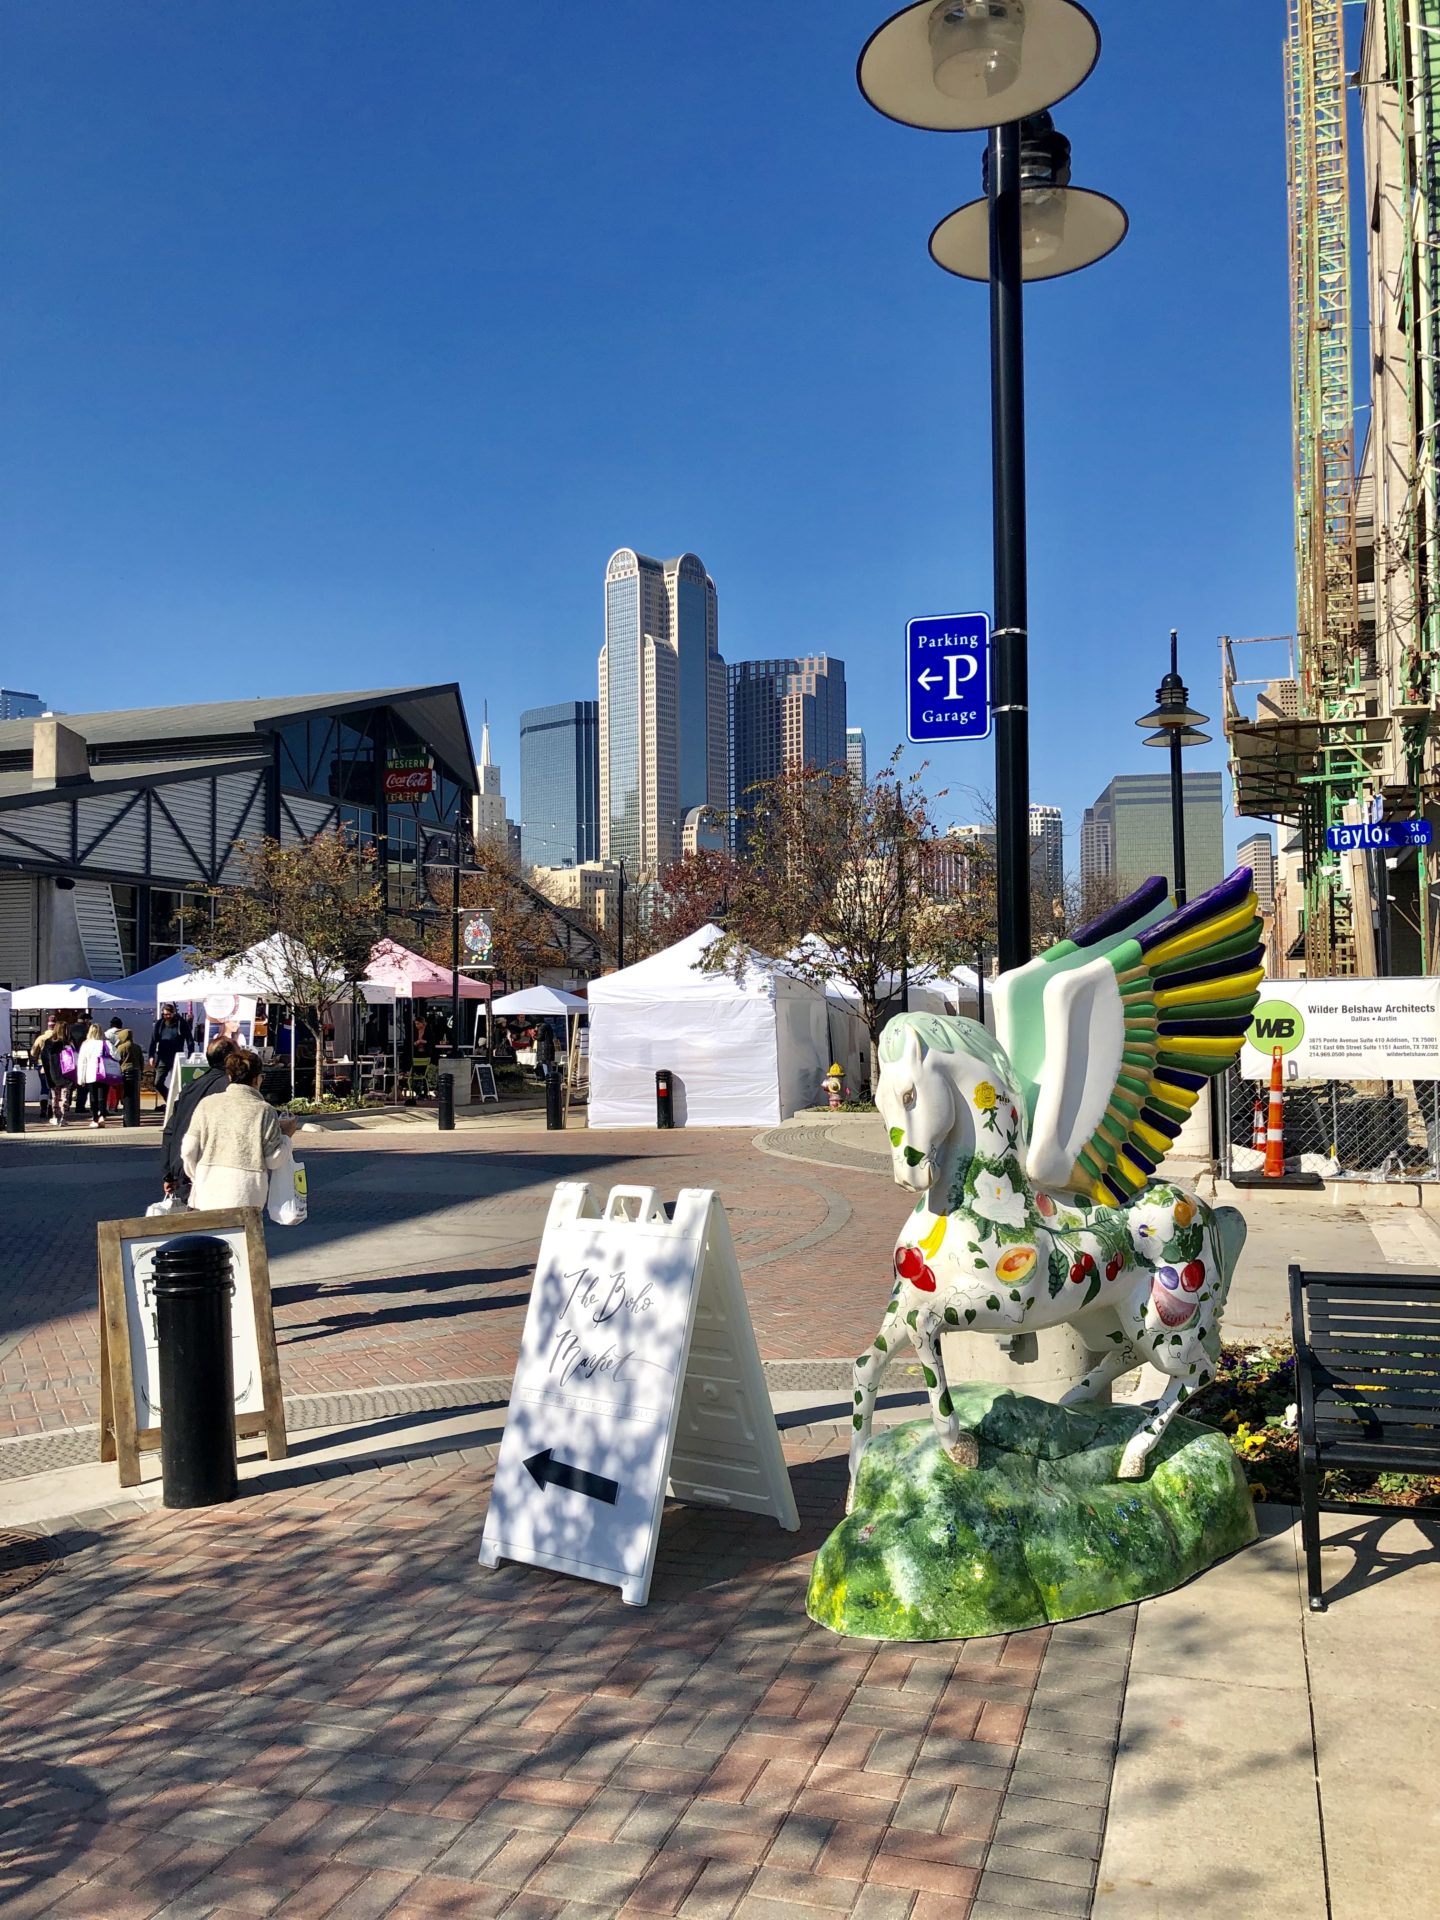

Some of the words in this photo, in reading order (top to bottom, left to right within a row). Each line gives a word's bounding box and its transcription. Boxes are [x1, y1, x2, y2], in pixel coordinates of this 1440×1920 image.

[918, 633, 978, 648] Parking
[943, 654, 978, 700] P
[922, 710, 977, 724] Garage
[387, 759, 425, 769] WESTERN
[1331, 825, 1391, 848] Taylor
[1410, 823, 1420, 832] St
[1405, 834, 1427, 844] 2100
[1308, 1005, 1338, 1014] Wilder
[1341, 1005, 1382, 1014] Belshaw
[1385, 1004, 1435, 1013] Architects
[1255, 1018, 1295, 1038] WB
[559, 1267, 599, 1320] The
[593, 1271, 654, 1328] Boho
[549, 1329, 672, 1387] Market
